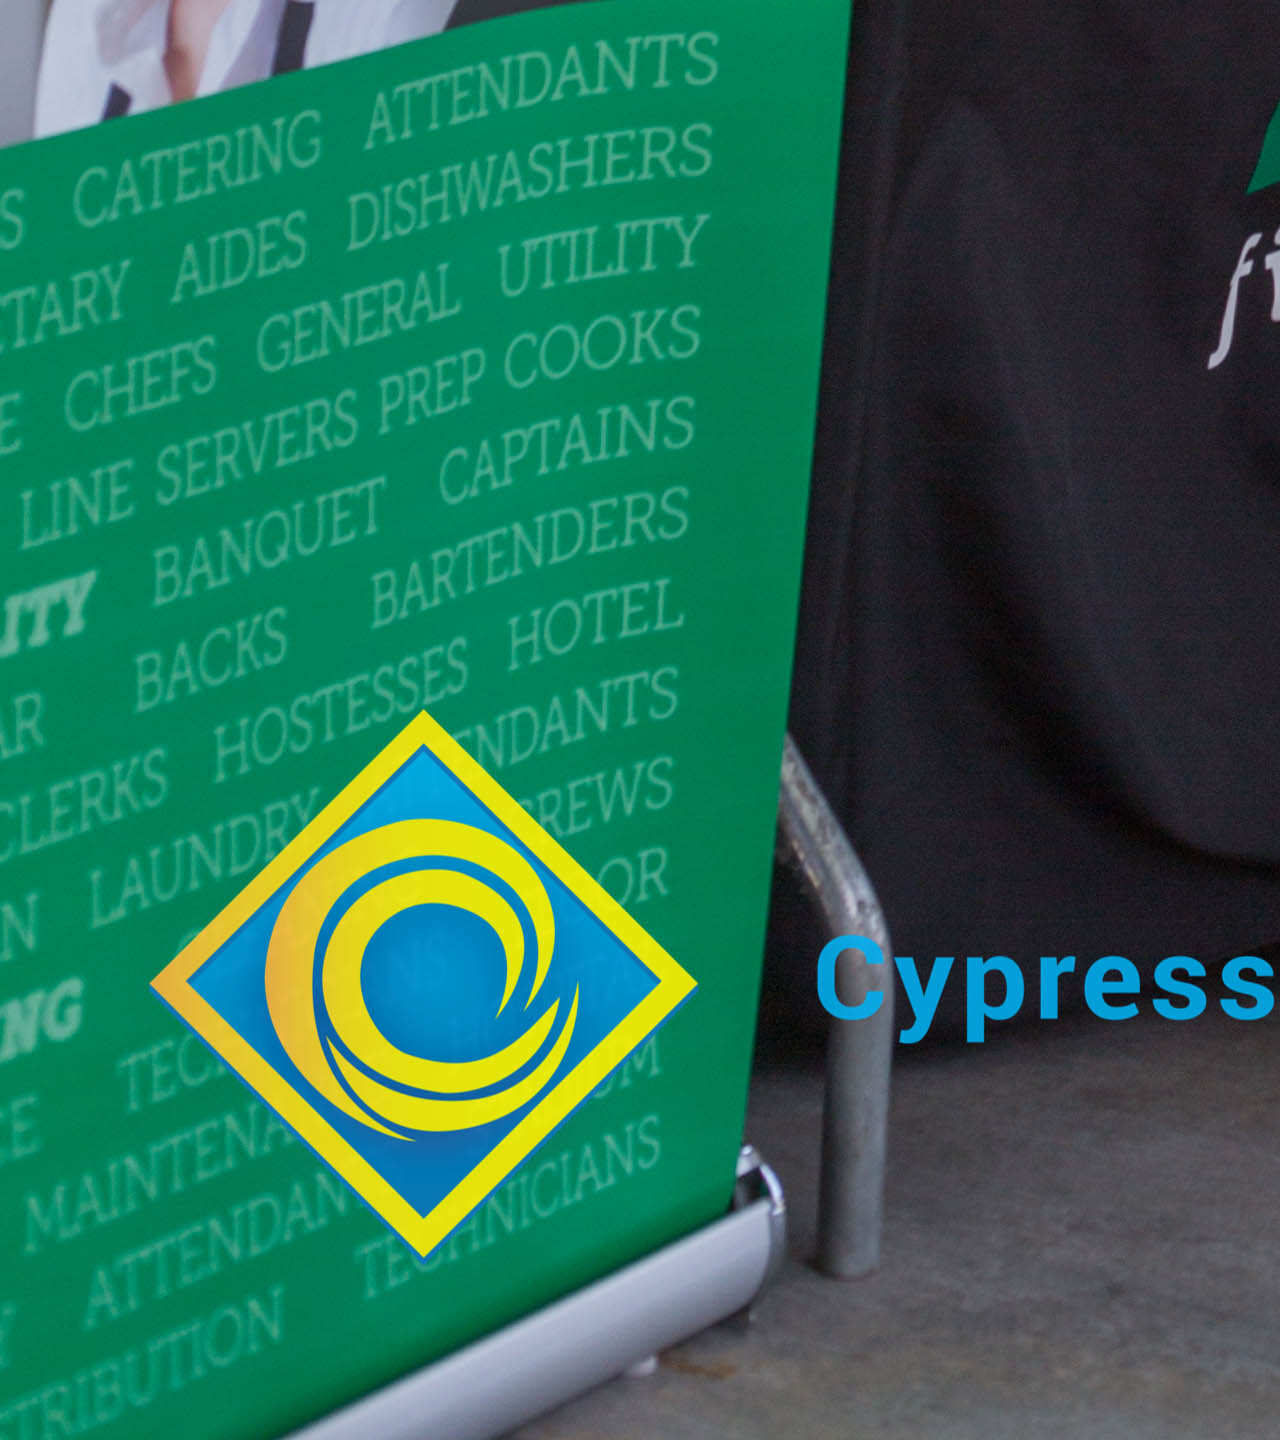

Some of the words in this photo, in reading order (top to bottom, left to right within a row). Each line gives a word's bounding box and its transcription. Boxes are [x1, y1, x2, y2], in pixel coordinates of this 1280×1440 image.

[72, 109, 323, 229] CATERING
[362, 30, 721, 152] ATTENDANTS
[0, 258, 132, 356] TARY
[170, 211, 309, 304] AIDES
[346, 123, 714, 253] DISHWASHERS
[63, 334, 219, 433] CHEFS
[256, 262, 463, 374] GENERAL
[497, 213, 711, 299] UTILITY
[17, 459, 137, 552] LINE
[155, 389, 359, 506] SERVERS
[378, 347, 488, 436] PREP
[503, 303, 703, 389] COOKS
[151, 475, 387, 608] BANQUET
[438, 394, 696, 506] CAPTAINS
[133, 607, 289, 714] BACKS
[370, 485, 692, 630] BARTENDERS
[212, 636, 471, 784] HOSTESSES
[507, 577, 687, 673] HOTEL
[451, 665, 681, 770] NDANTS
[519, 754, 676, 839] REWS
[115, 1029, 228, 1114] TEC
[82, 1163, 367, 1333] ATTENDAN
